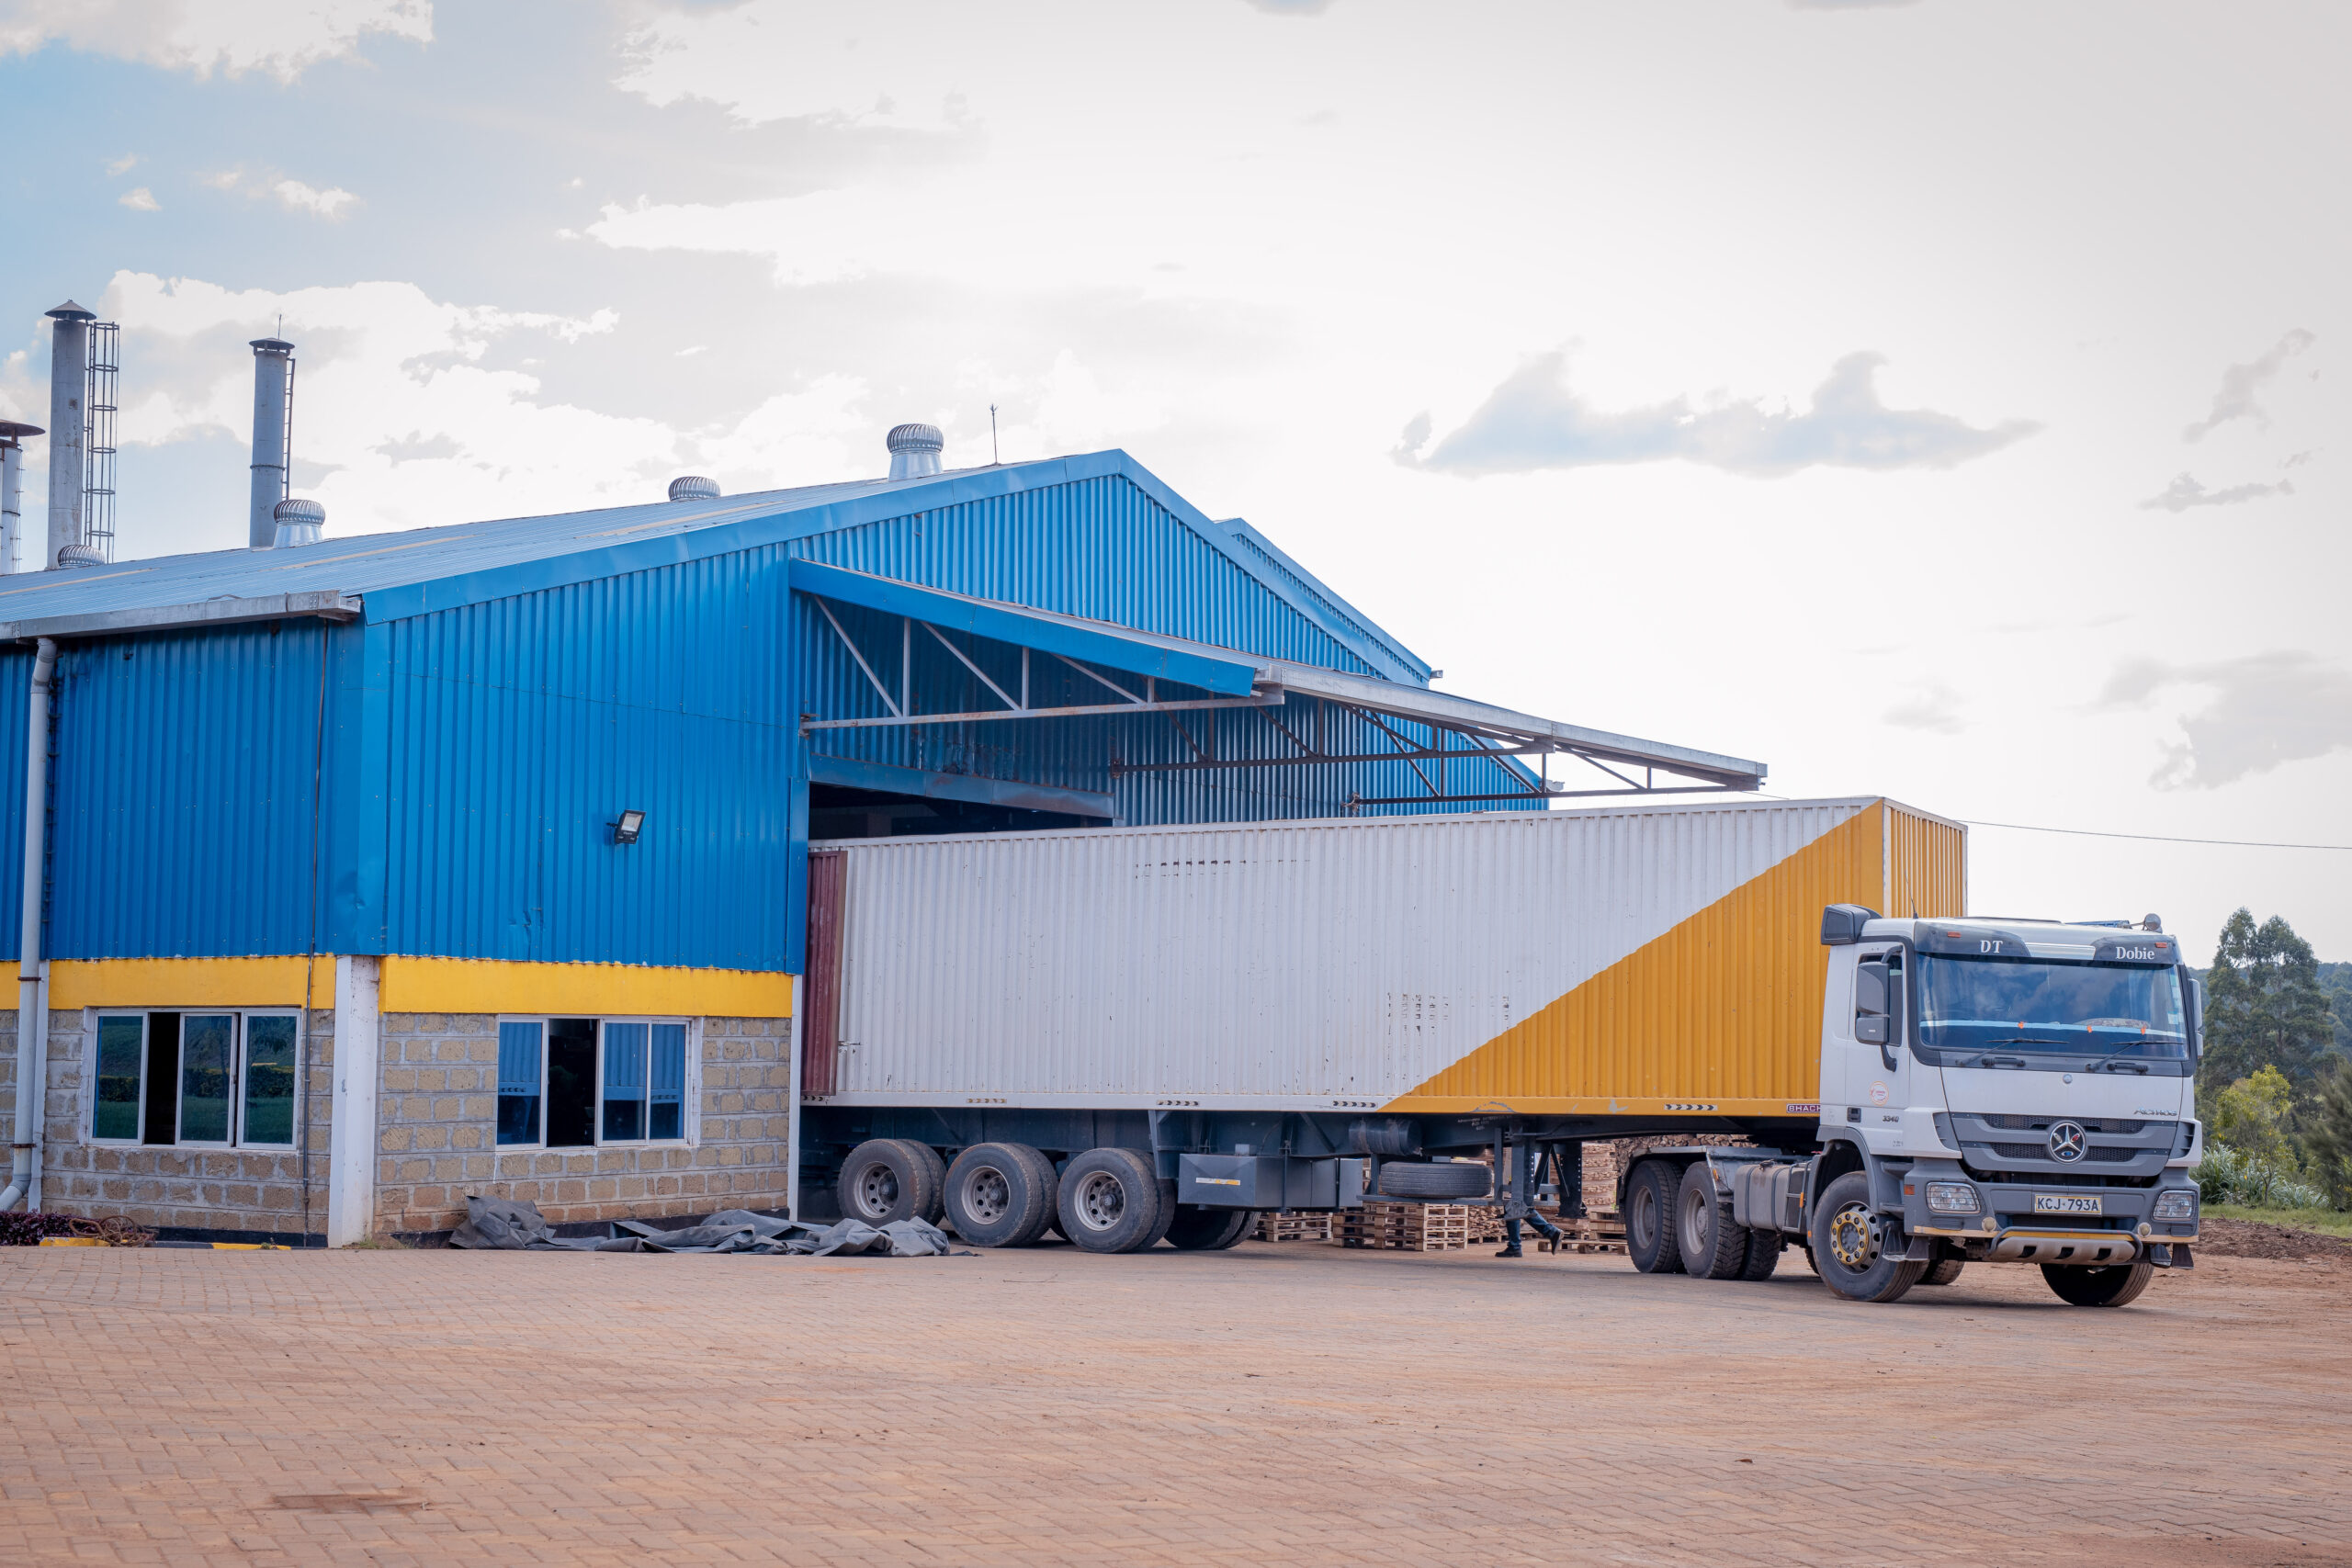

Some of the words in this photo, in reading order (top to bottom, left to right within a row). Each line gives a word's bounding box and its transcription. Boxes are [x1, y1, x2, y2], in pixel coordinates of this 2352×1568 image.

[1980, 940, 2003, 953] DT
[2115, 946, 2155, 960] Dobie
[2037, 1197, 2061, 1211] KCJ
[2067, 1198, 2099, 1212] 793A
